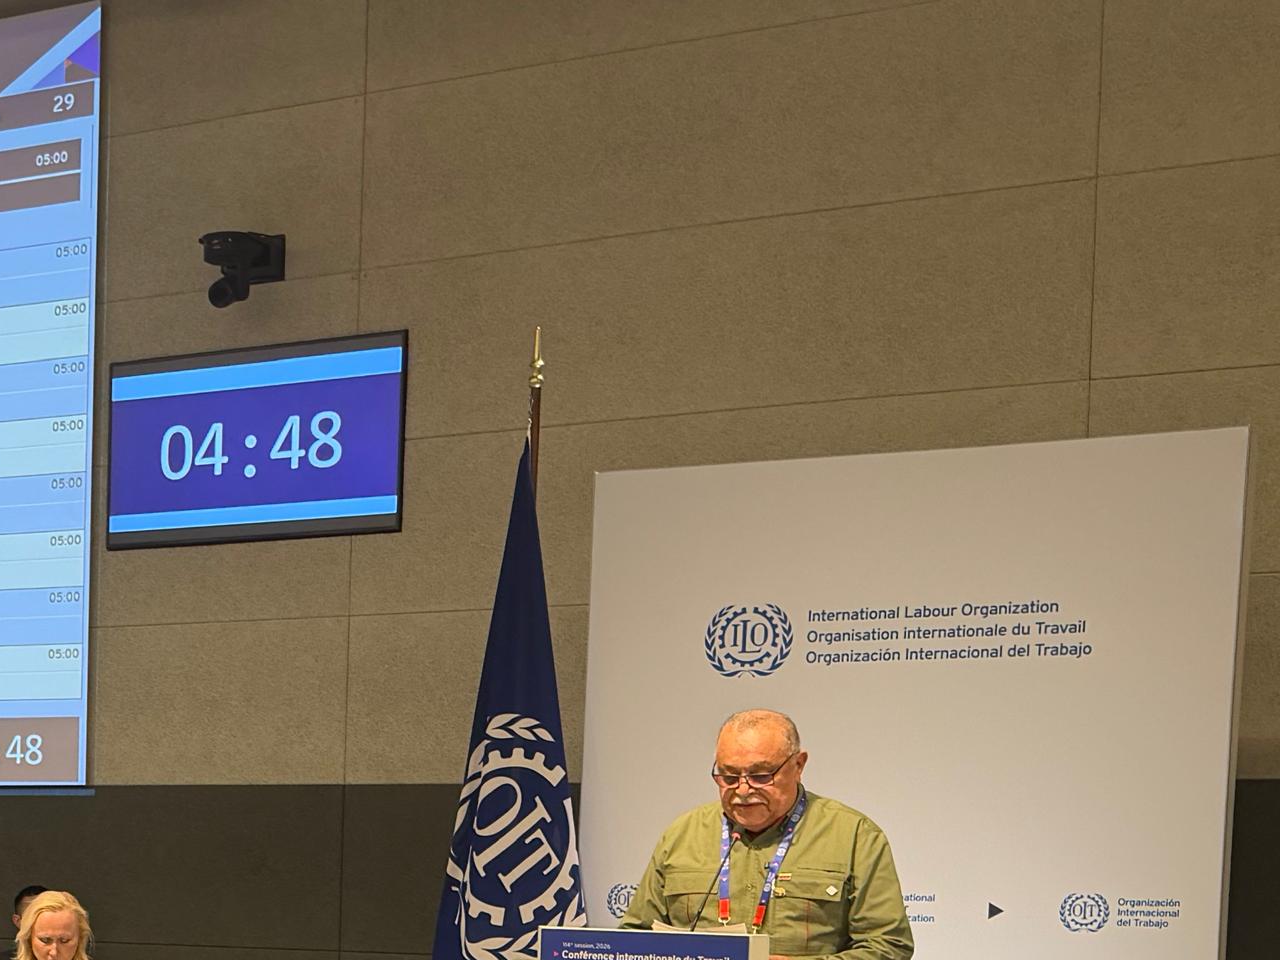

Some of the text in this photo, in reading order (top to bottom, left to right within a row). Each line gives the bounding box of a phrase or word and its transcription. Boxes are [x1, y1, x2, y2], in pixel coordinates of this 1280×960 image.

[52, 91, 75, 113] 29
[34, 149, 69, 168] 05:00
[54, 243, 87, 259] 05:00
[53, 302, 86, 318] 05:00
[52, 360, 85, 376] 05:00
[51, 418, 84, 433] 05:00
[160, 411, 342, 480] 04:48
[50, 476, 83, 491] 05:00
[49, 533, 82, 548] 05:00
[48, 590, 81, 604] 05:00
[808, 601, 1059, 623] International Labour Organization
[730, 618, 768, 656] ILO
[807, 620, 1087, 645] Organisation internationale du Travail
[47, 647, 80, 661] 05:00
[806, 642, 1093, 666] Organización Internacional del Trabajo
[472, 775, 561, 894] OIT
[903, 893, 936, 902] ational
[1117, 897, 1181, 909] Organización
[1071, 900, 1099, 921] OIT
[1117, 907, 1180, 918] Internacional
[1116, 918, 1169, 929] del Trabajo
